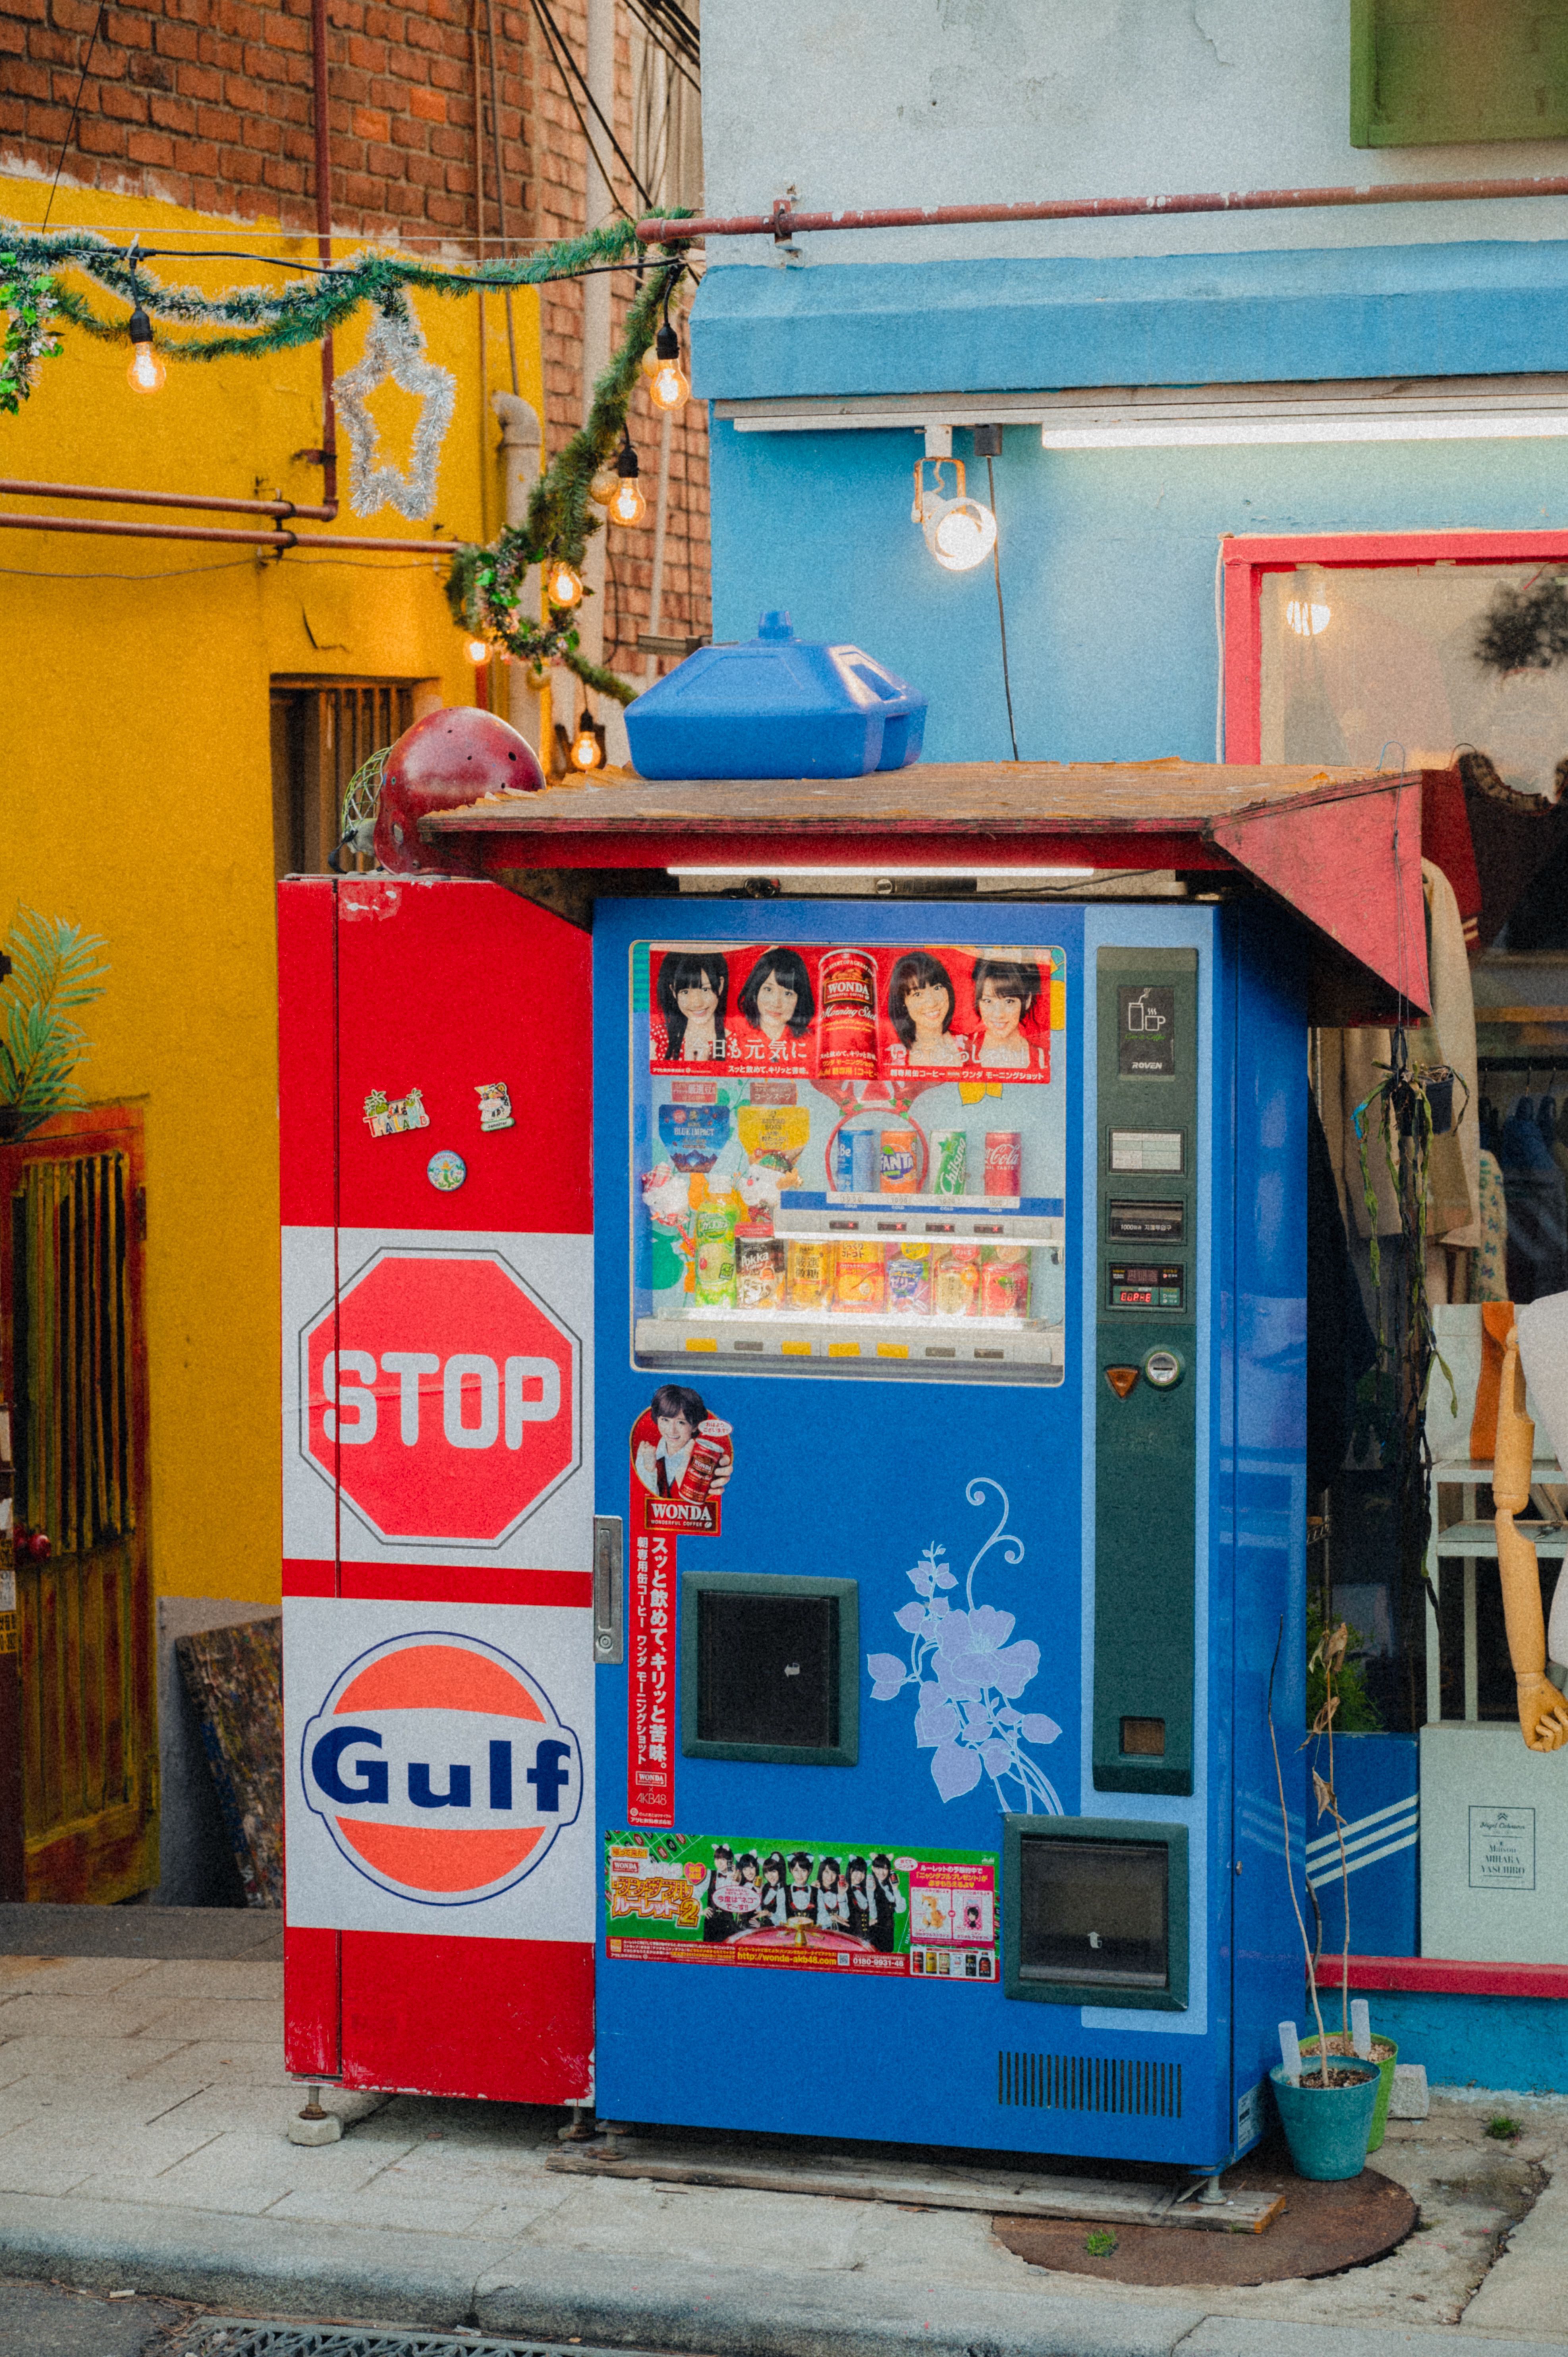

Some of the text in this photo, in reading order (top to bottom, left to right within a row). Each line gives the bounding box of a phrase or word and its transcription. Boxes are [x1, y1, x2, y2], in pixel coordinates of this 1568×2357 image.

[828, 981, 870, 995] WONDA
[819, 1004, 858, 1022] Morning
[692, 1038, 807, 1061] 今日も元気に
[363, 1105, 428, 1138] THAILAND
[691, 1128, 714, 1136] IMPACT
[741, 1251, 769, 1267] Pokka
[322, 1350, 562, 1451] STOP
[651, 1503, 712, 1521] WONDA
[636, 1536, 648, 1765] 朝専用缶コーヒー ワンダ モーニングショット
[649, 1536, 668, 1769] スッと飲めて、キリッと苦味。
[311, 1726, 572, 1812] Gulf
[636, 1793, 667, 1806] AKB48
[1489, 1844, 1516, 1853] Maison
[612, 1876, 693, 1901] ワンダフル
[613, 1894, 701, 1927] ルーレット 2
[737, 1952, 837, 1965] http://wonda-akb48.com
[853, 1957, 904, 1967] 0180-9931-48
